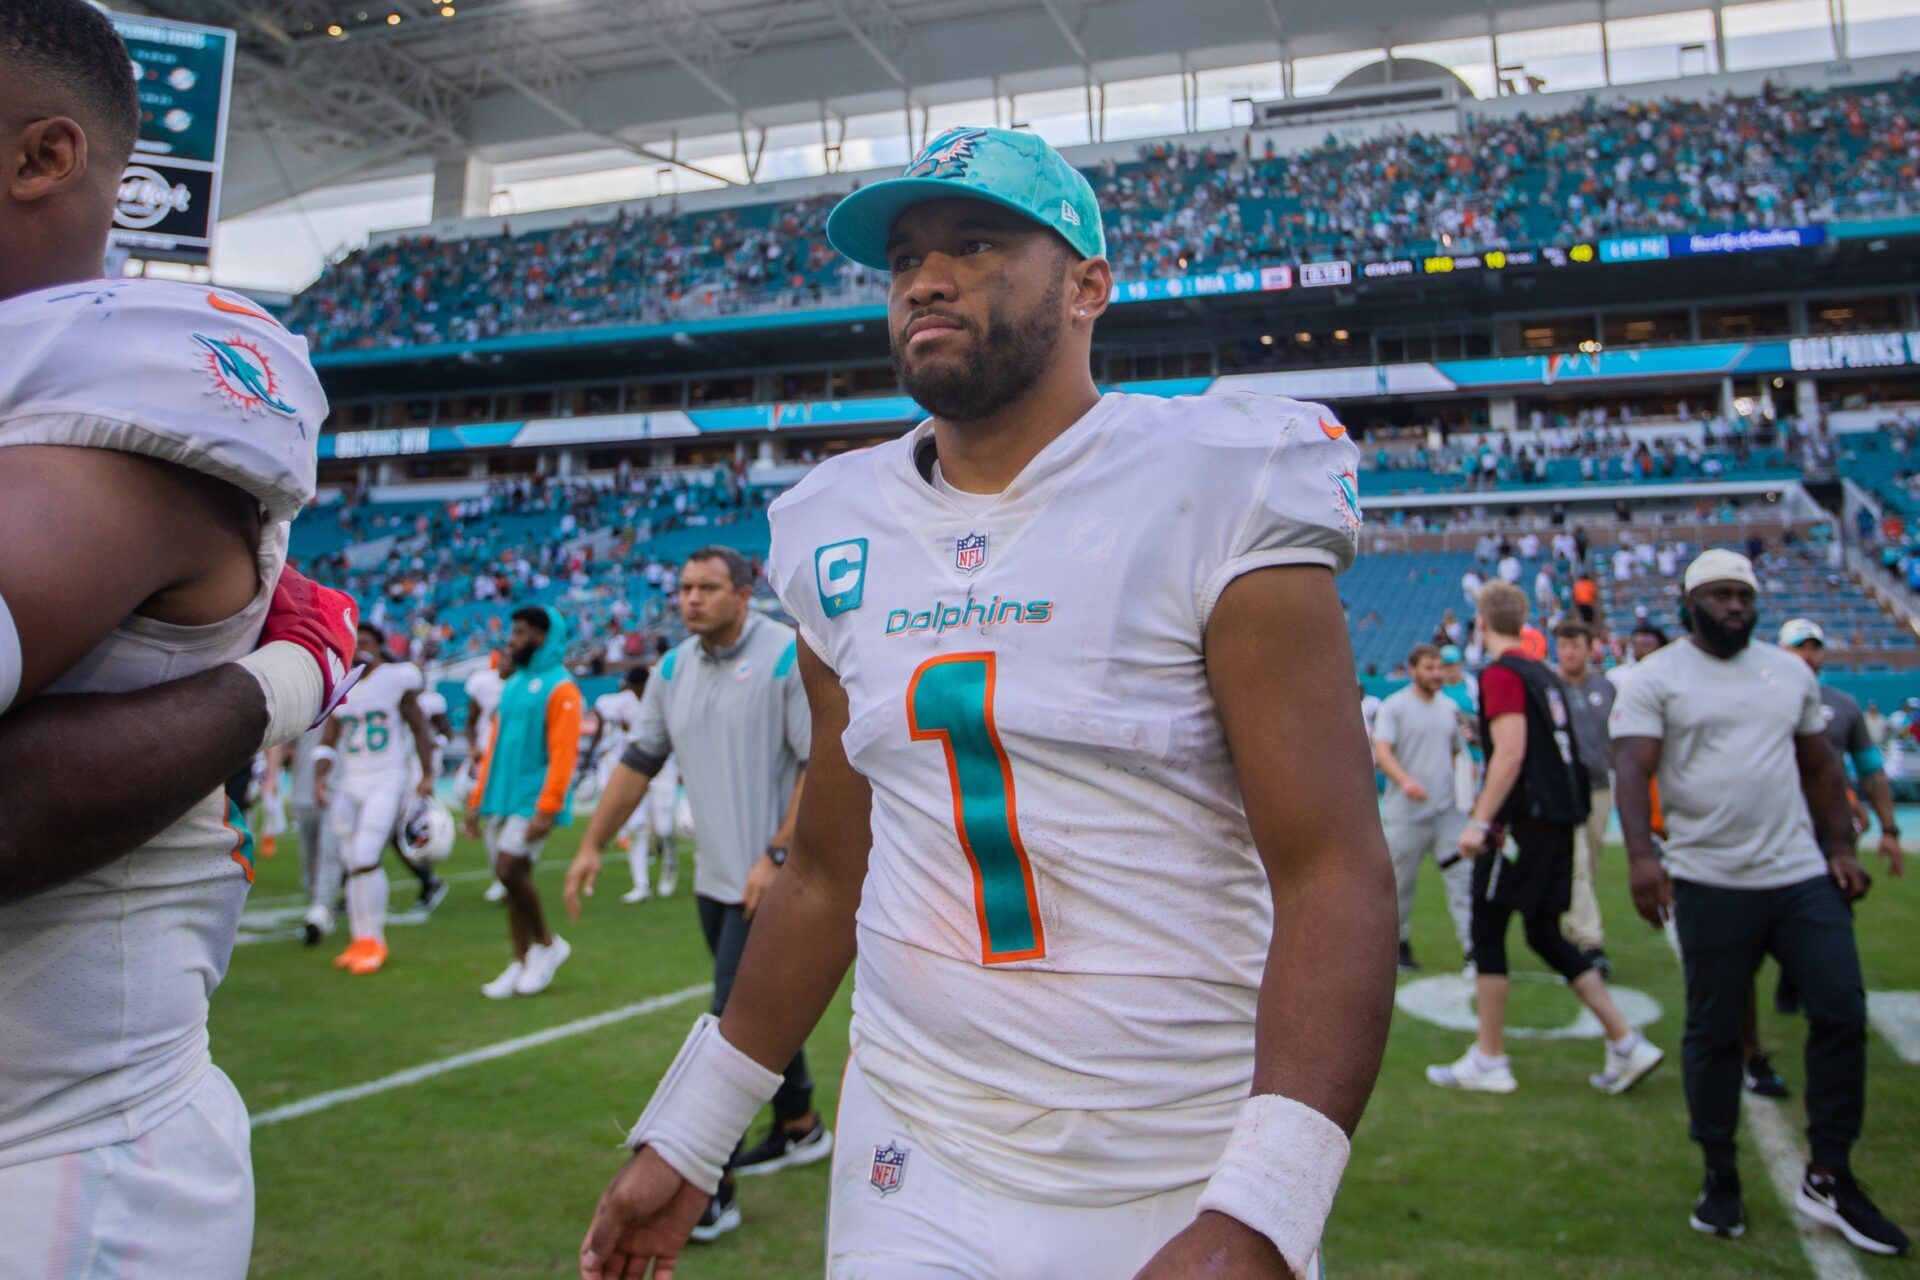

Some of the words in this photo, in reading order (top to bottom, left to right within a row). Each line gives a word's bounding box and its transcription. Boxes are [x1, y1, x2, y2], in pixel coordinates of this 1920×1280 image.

[1789, 332, 1907, 371] DOLPHINS
[818, 543, 863, 598] C
[958, 547, 983, 568] NFL
[884, 595, 1053, 637] Dolphins
[339, 710, 390, 753] 26
[906, 651, 1046, 965] 1
[873, 1164, 897, 1186] NFL
